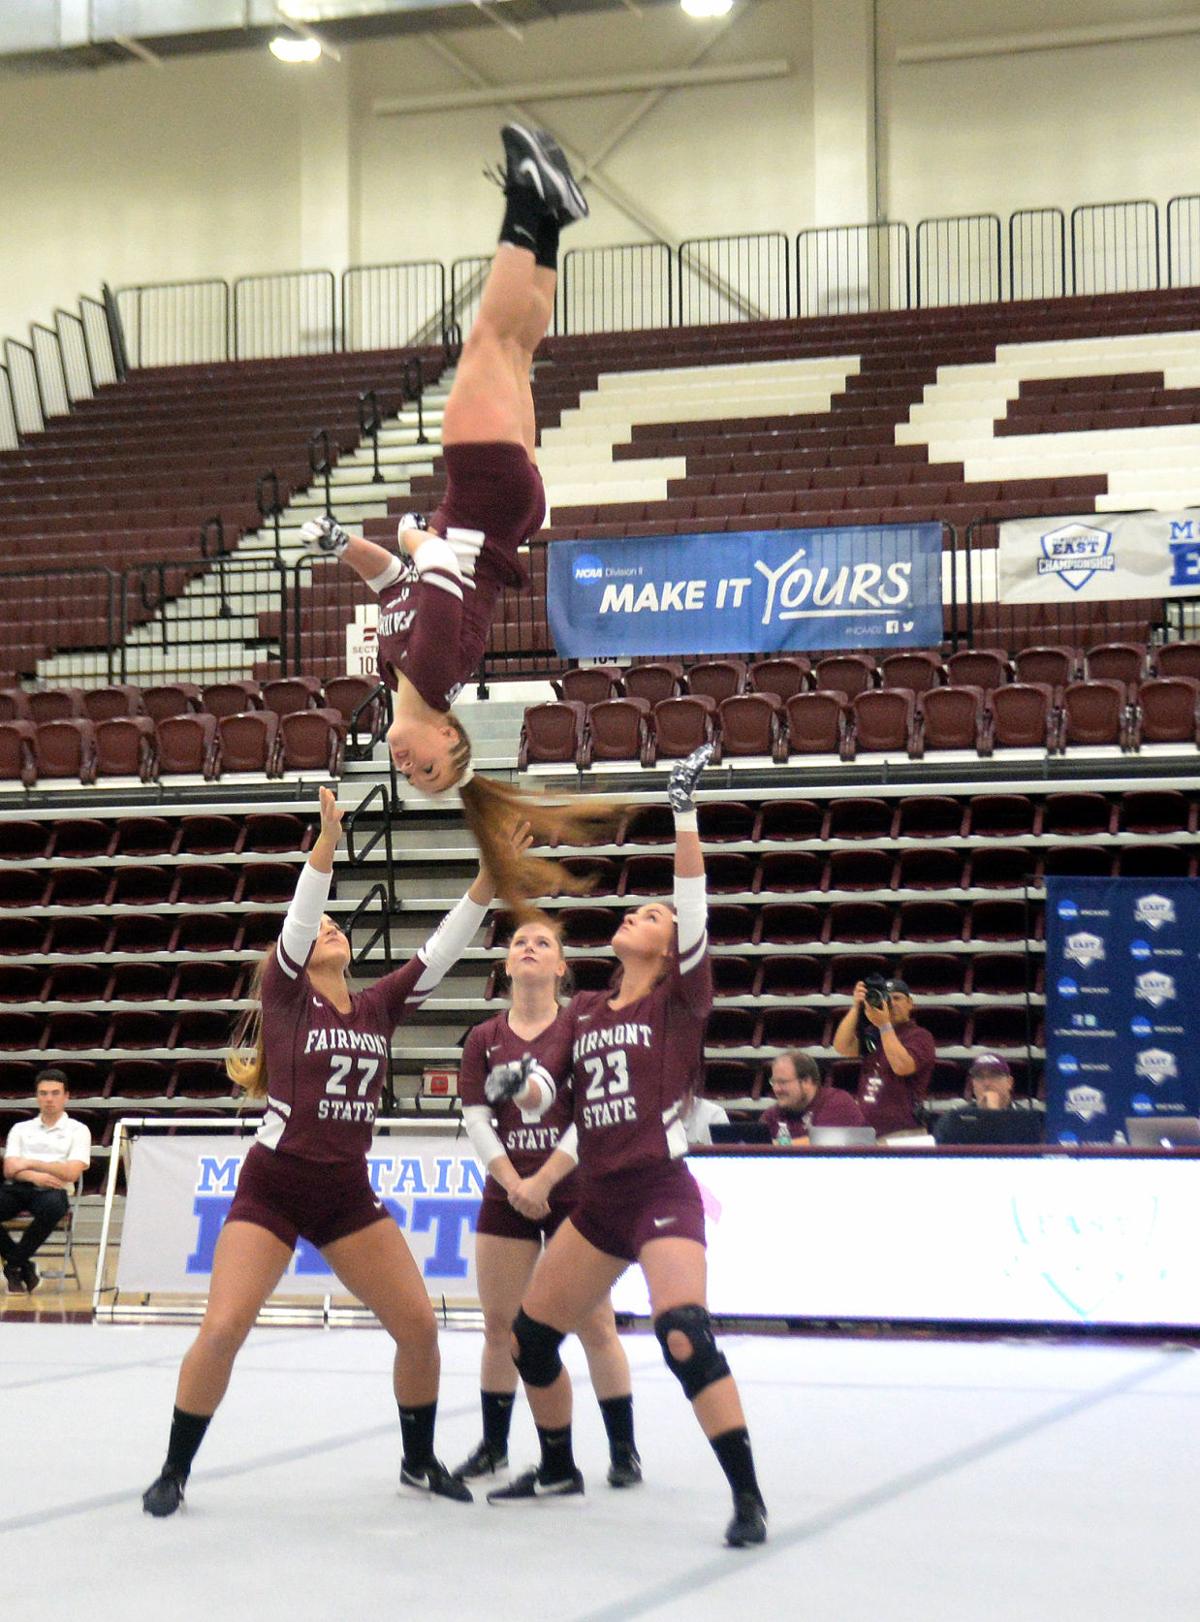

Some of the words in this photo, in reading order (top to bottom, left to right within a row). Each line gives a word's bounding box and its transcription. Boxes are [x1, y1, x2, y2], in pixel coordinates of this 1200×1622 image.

[1052, 542, 1099, 555] EAST
[605, 567, 637, 577] Division
[1039, 556, 1114, 573] CHAMPIONSHIP
[599, 580, 706, 614] MAKE
[716, 578, 752, 609] IT
[753, 549, 913, 625] YOURS
[359, 656, 379, 675] 10
[325, 1054, 379, 1097] 27
[584, 1049, 629, 1100] 23
[317, 1099, 375, 1123] STATE
[583, 1096, 637, 1130] STATE
[506, 1127, 559, 1150] STATE
[197, 1158, 486, 1193] MTAIN
